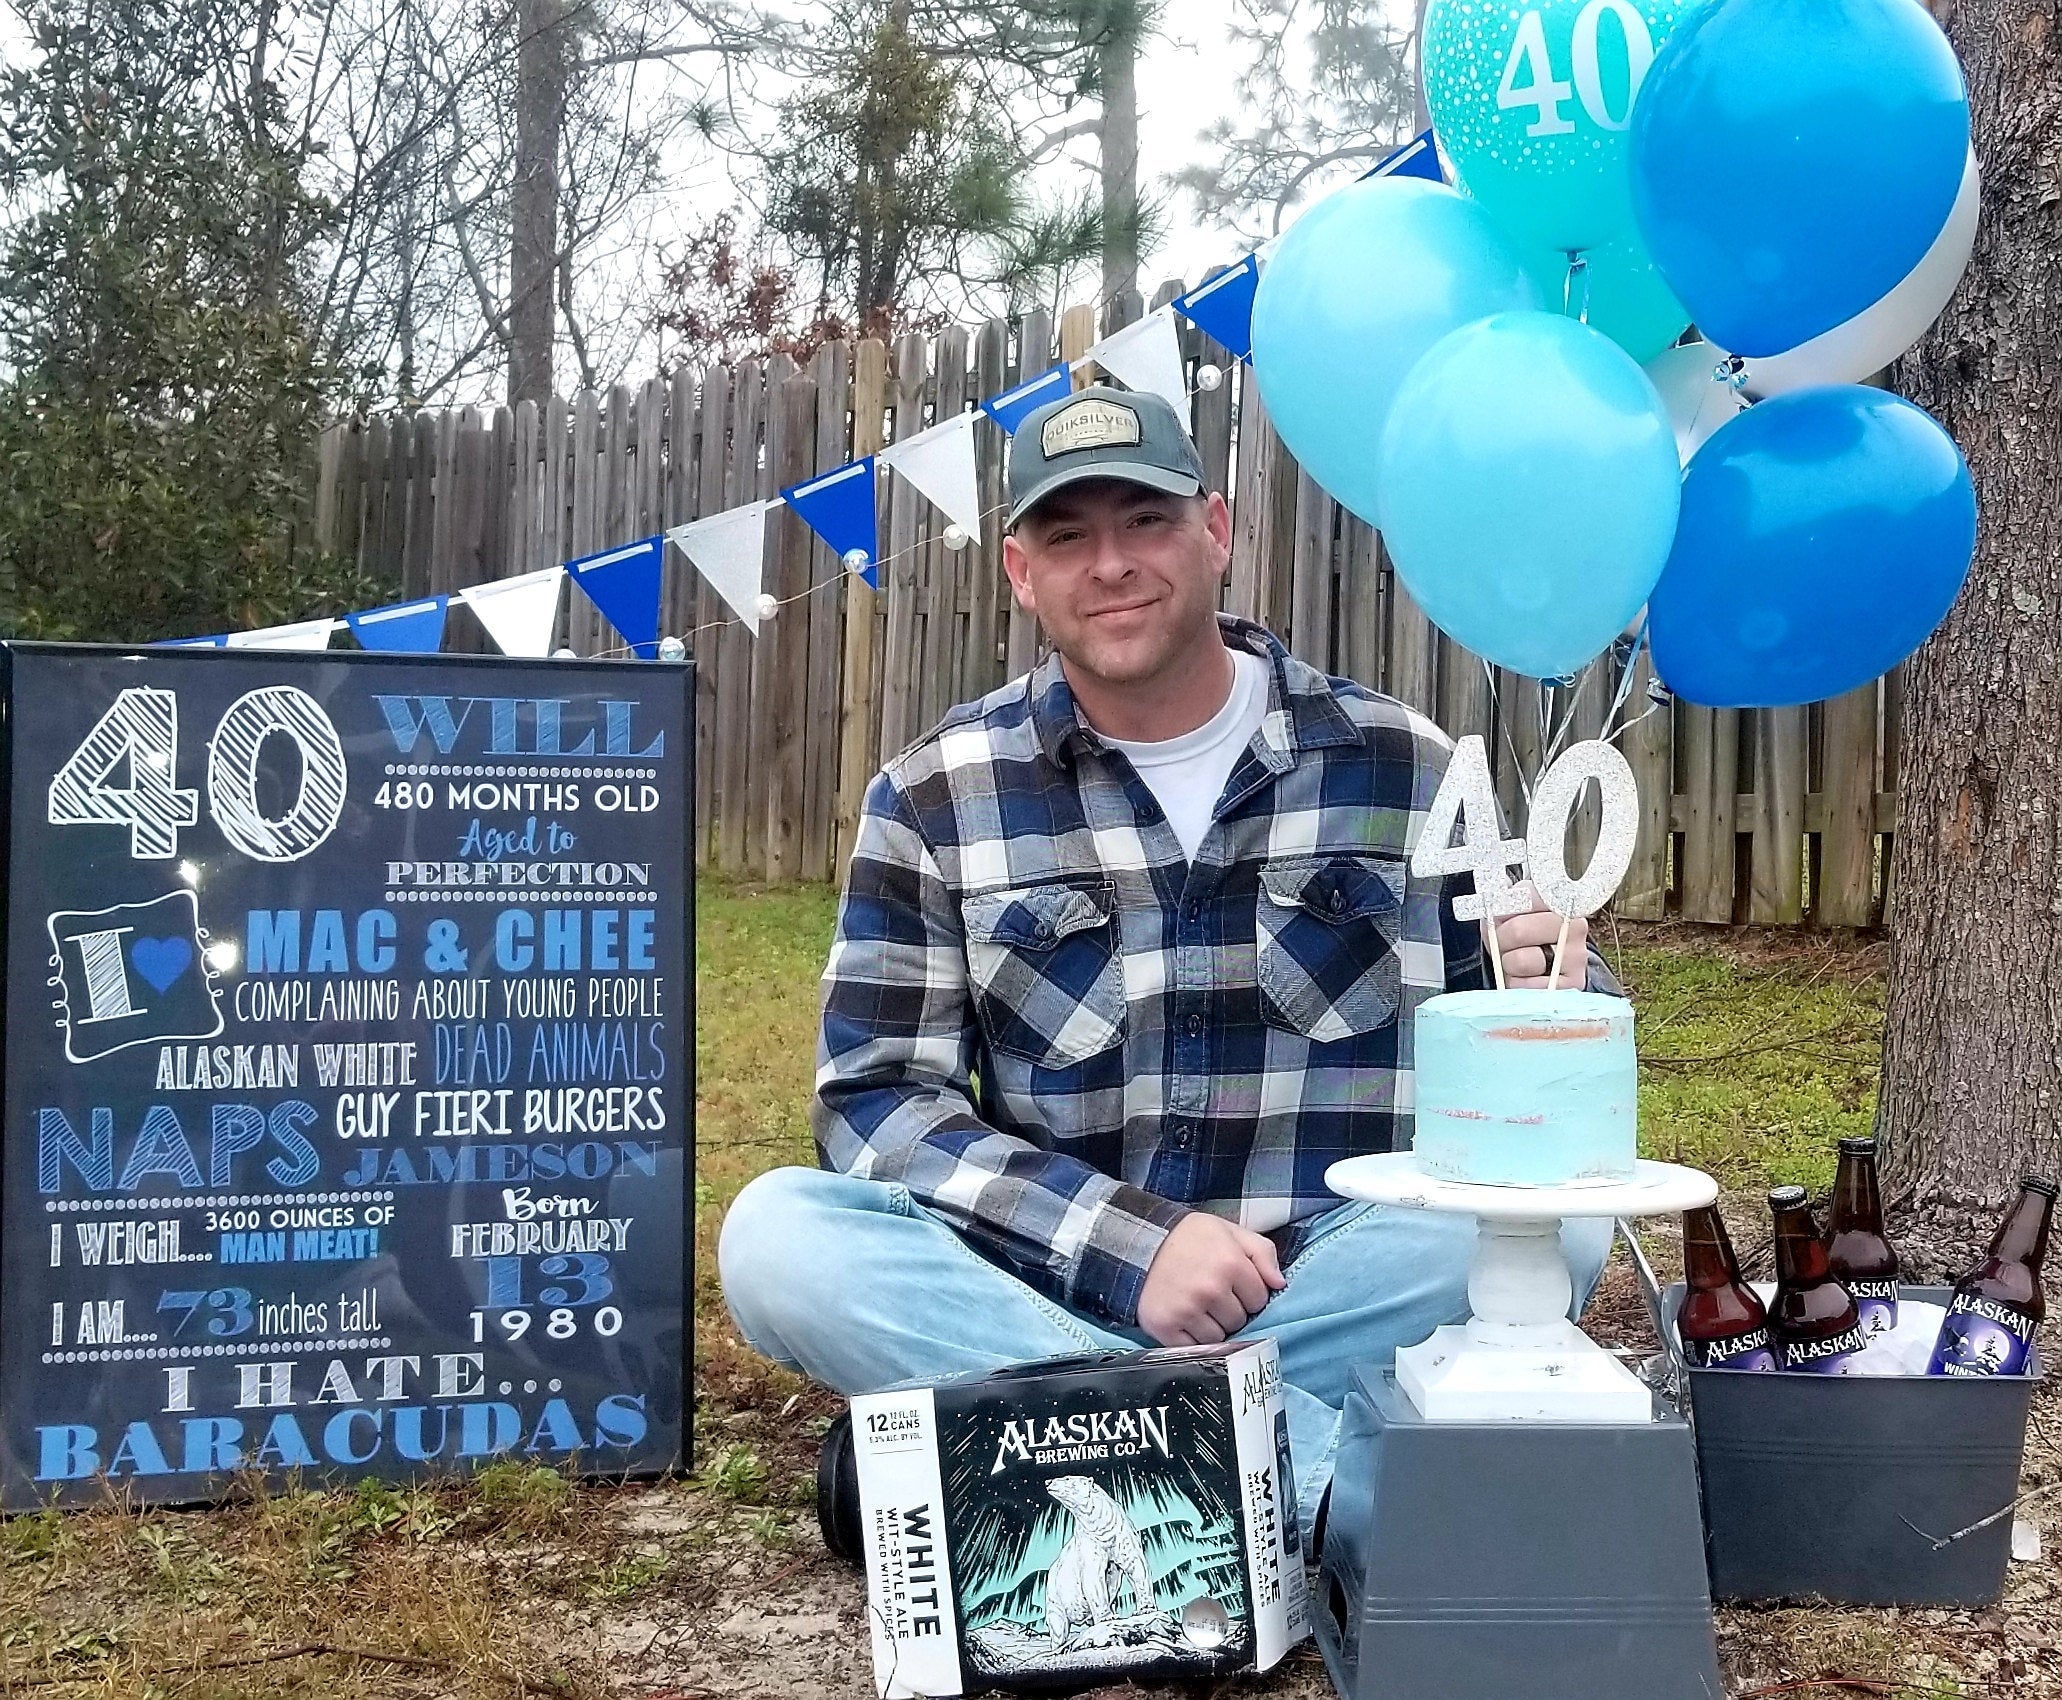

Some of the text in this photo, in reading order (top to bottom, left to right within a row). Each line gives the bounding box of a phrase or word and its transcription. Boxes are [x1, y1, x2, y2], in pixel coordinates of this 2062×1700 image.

[1496, 0, 1653, 137] 40
[1047, 413, 1134, 440] QUIKSILVER
[371, 694, 664, 758] WILL
[48, 685, 348, 862] 40
[374, 781, 660, 812] 480 MONTHS OLD
[456, 816, 578, 861] Aged to
[1411, 734, 1639, 921] 40
[384, 861, 652, 886] PERFECTION
[247, 909, 656, 973] MAC & CHEE
[64, 927, 148, 1025] I
[235, 977, 664, 1022] COMPLAINING ABOUT YOUNG PEOPLE
[155, 1042, 417, 1090] ALASKAN WHITE
[434, 1022, 665, 1085] DEAD ANIMALS
[336, 1087, 666, 1138] GUY FIERI BURGERS
[38, 1100, 320, 1194] NAPS
[343, 1141, 661, 1186] JAMESON
[205, 1206, 395, 1231] 3600 OUNCES OF
[502, 1186, 599, 1221] Born
[50, 1223, 62, 1267] I
[220, 1228, 378, 1265] MAN MEAT!
[450, 1217, 634, 1258] FEBRUARY
[474, 1253, 613, 1309] 13
[1847, 1280, 1898, 1303] ASKAN
[52, 1302, 64, 1346] I
[156, 1287, 382, 1337] 73 inches tall
[1947, 1293, 2033, 1345] ALASKAN
[1706, 1328, 1770, 1368] ALASKA
[1786, 1325, 1866, 1366] ALASKAN
[161, 1366, 196, 1413] I
[34, 1394, 647, 1481] BARACUDAS
[867, 1413, 888, 1432] 12
[891, 1418, 920, 1430] CANS
[991, 1406, 1169, 1475] ALASKAN
[1035, 1442, 1141, 1465] BREWING CO.
[1262, 1466, 1281, 1602] WHITE
[876, 1509, 894, 1641] BREWED WITH SPICES
[886, 1507, 909, 1639] WIT-STYLE ALE
[903, 1503, 942, 1637] WHITE
